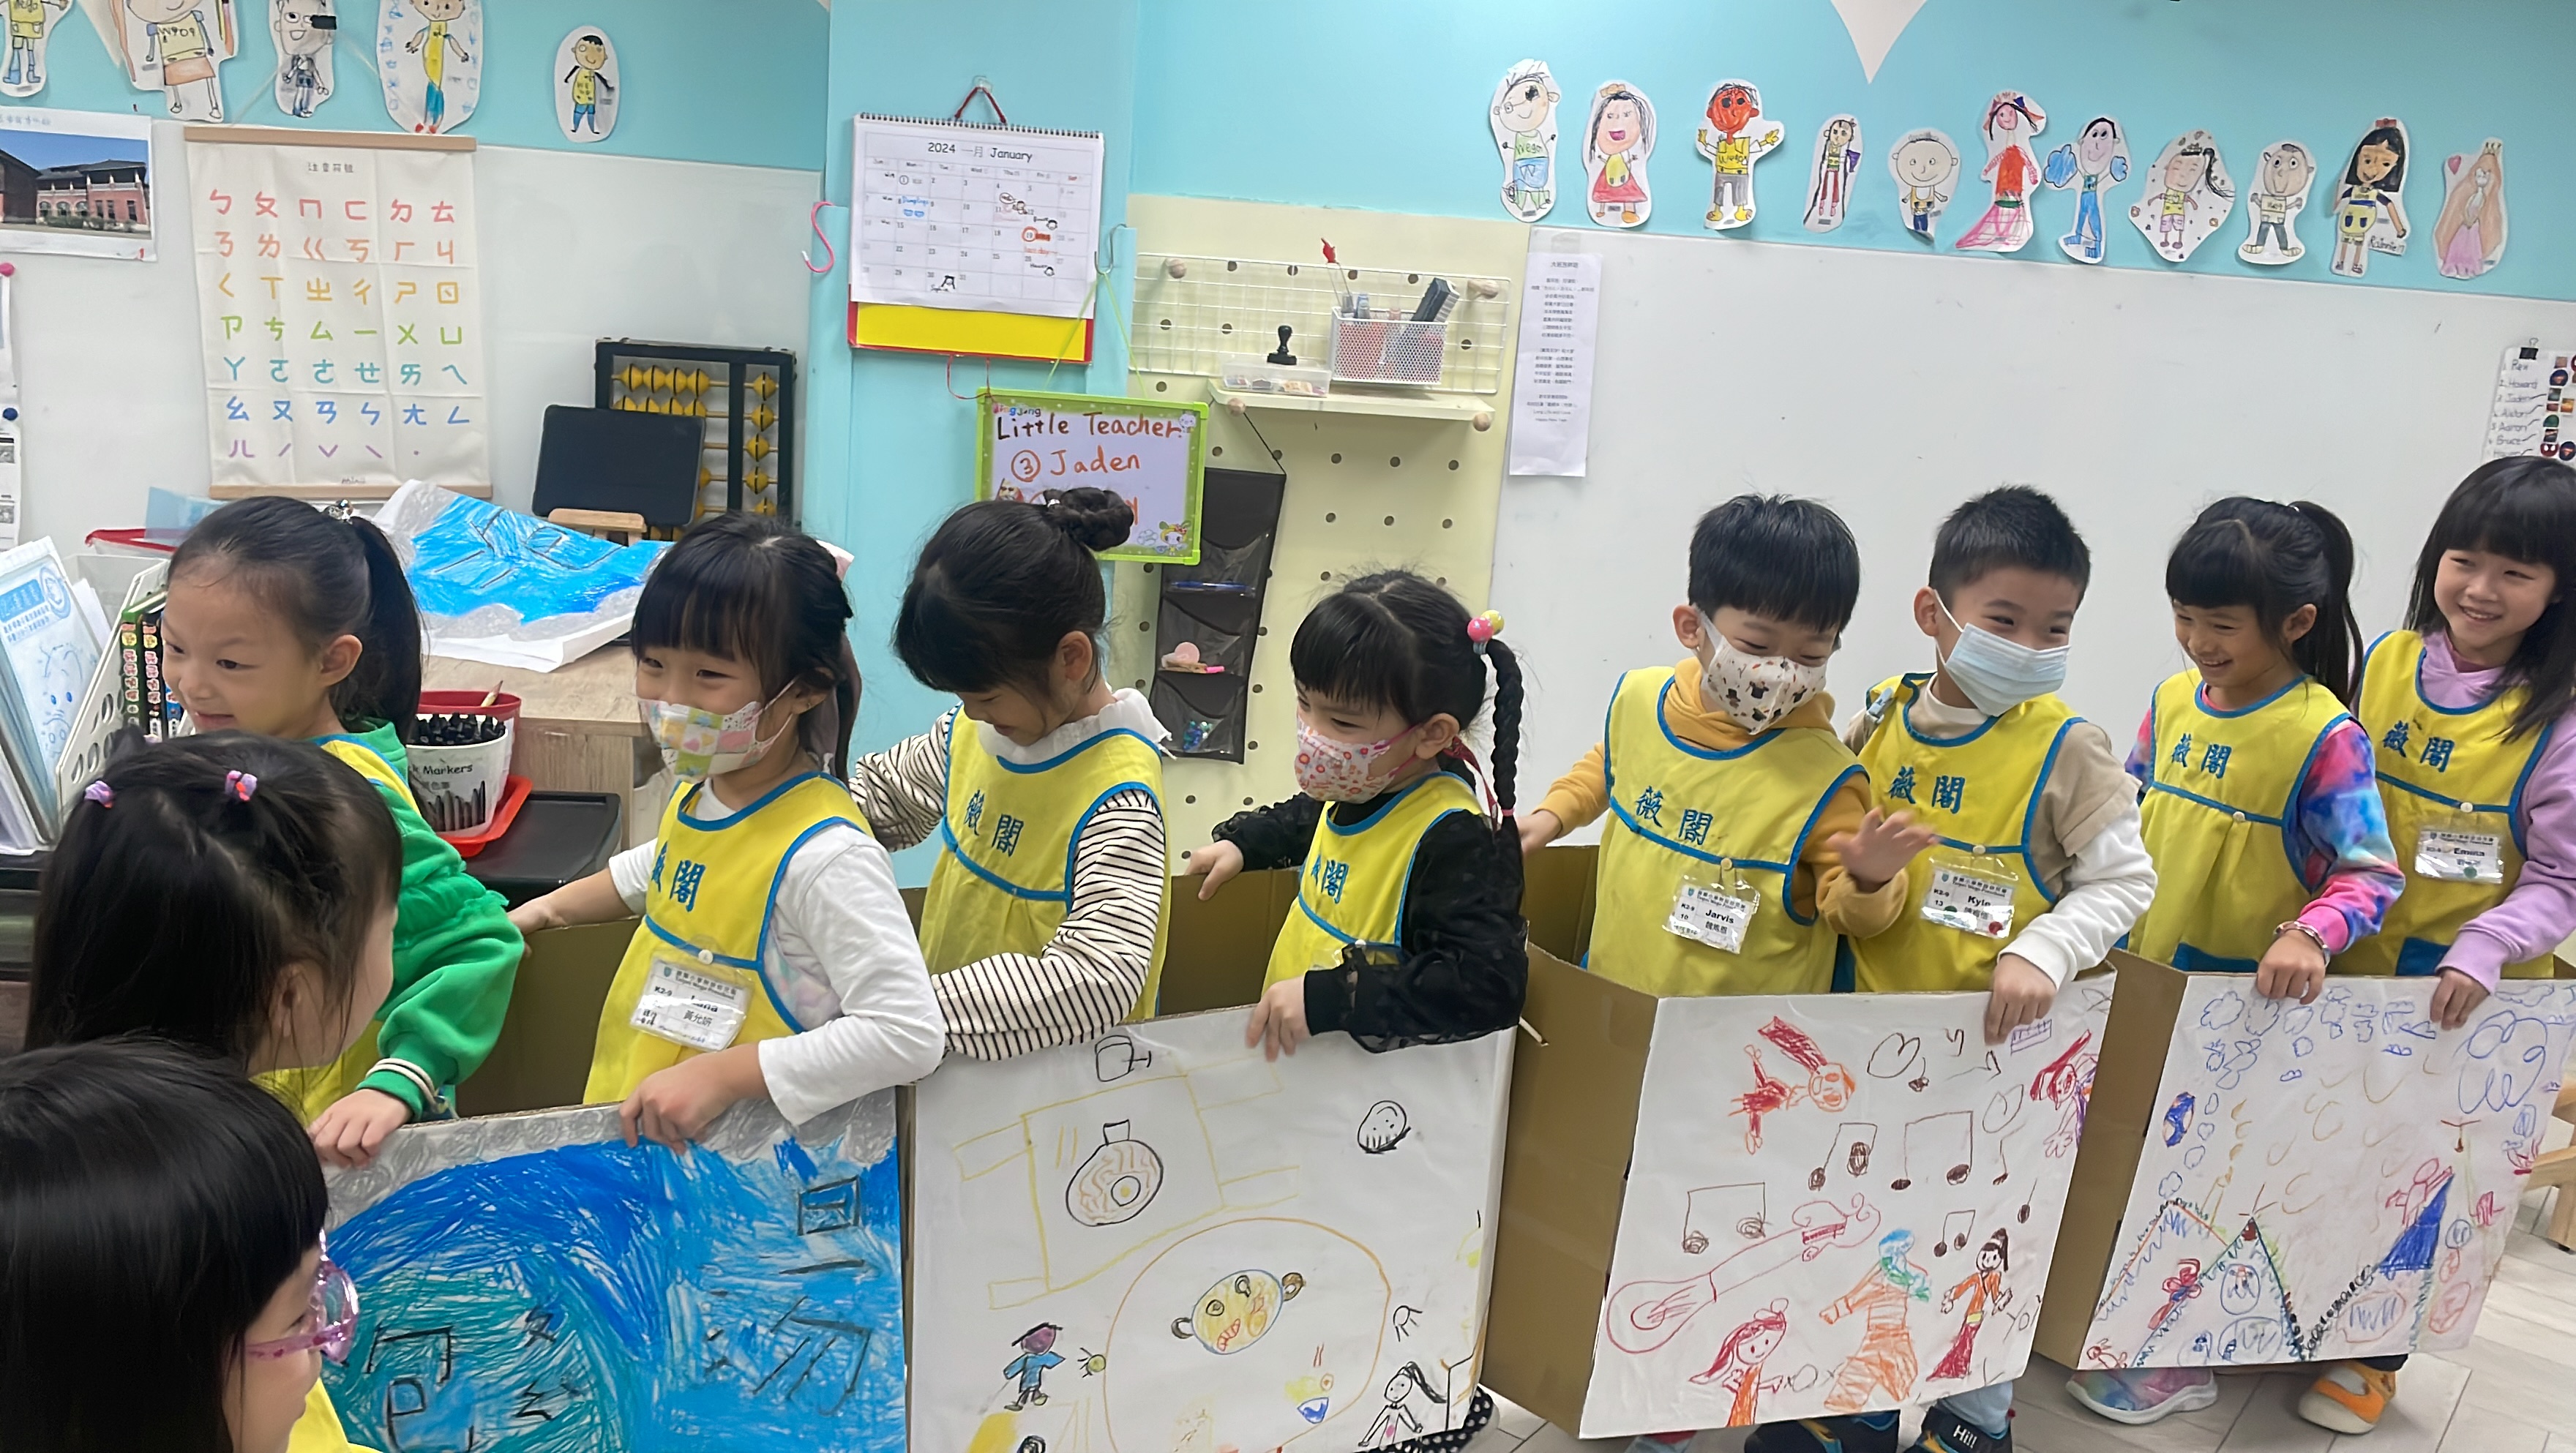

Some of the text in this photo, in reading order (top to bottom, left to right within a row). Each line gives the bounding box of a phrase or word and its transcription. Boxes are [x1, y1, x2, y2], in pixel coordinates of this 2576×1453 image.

[928, 142, 1033, 163] 2024 一月 January
[210, 189, 454, 222] ㄅ ㄆ ㄇ ㄈ ㄉ ㄊ
[215, 231, 454, 263] ㄋ ㄌ ㄍ ㄎ ㄏ ㄐ
[218, 273, 460, 305] ㄑ ㄒ ㄓ ㄔ ㄕ ㄖ
[220, 315, 243, 340] ㄗ
[263, 316, 285, 340] ㄘ
[310, 320, 333, 340] ㄙ
[398, 323, 418, 345] ㄨ
[440, 327, 463, 346] ㄩ
[225, 357, 467, 384] ㄚ ㄛ ㄜ ㄝ ㄞ ㄟ
[226, 397, 469, 426] ㄠ ㄡ ㄢ ㄣ ㄤ ㄥ
[997, 412, 1070, 440] Little
[230, 440, 255, 458] ㄦ
[1050, 445, 1141, 476] Jaden
[423, 764, 473, 776] Markers
[1705, 909, 1734, 924] Jarvis
[1953, 1424, 1978, 1449] Hill
